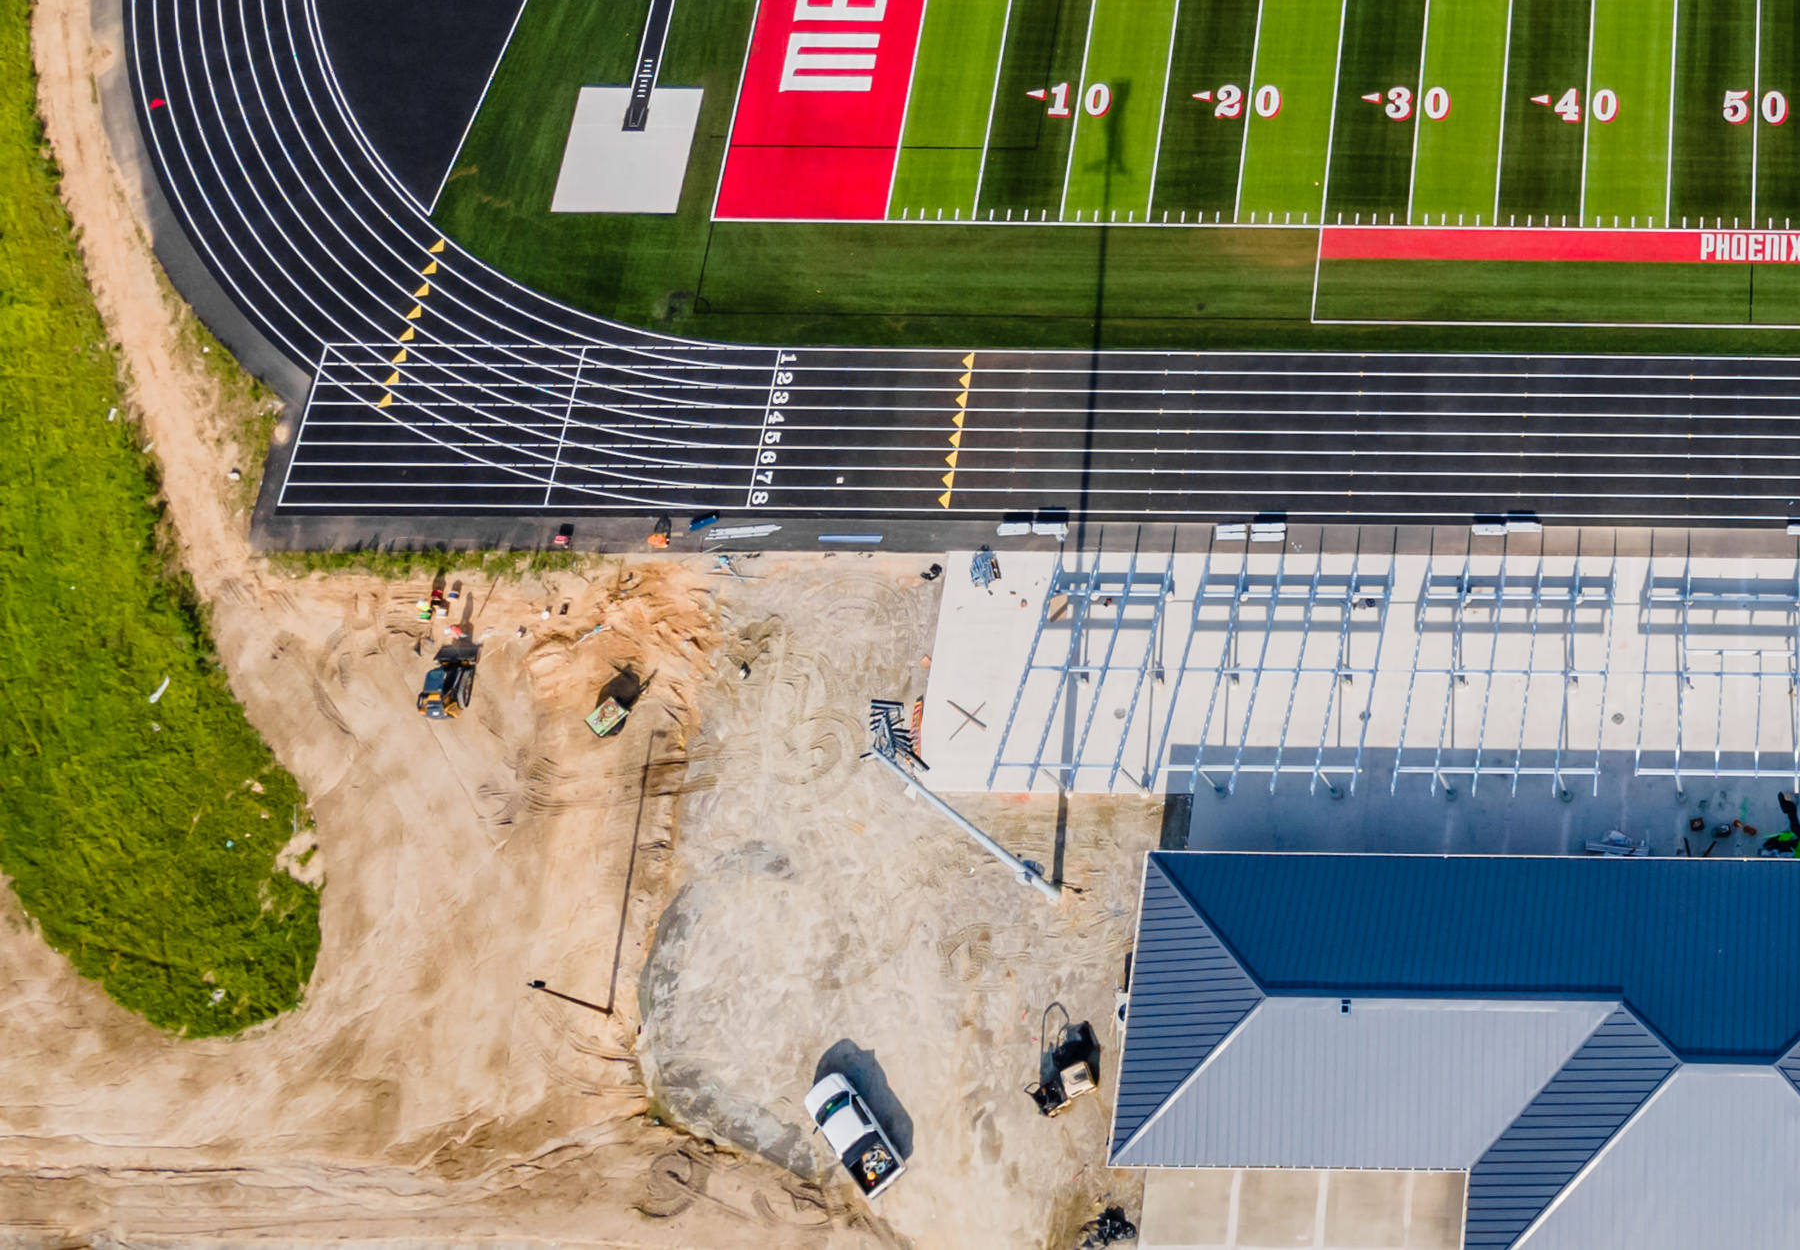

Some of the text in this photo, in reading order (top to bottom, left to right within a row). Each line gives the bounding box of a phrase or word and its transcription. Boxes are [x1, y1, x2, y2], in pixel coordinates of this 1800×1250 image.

[1047, 82, 1111, 117] 10
[1214, 84, 1281, 119] 20
[1384, 85, 1450, 121] 30
[1553, 87, 1618, 123] 40
[1722, 90, 1787, 124] 50
[780, 354, 797, 363] 1
[777, 372, 793, 385] 2
[773, 391, 789, 404] 3
[768, 411, 784, 424] 4
[764, 431, 781, 444] 5
[760, 451, 776, 464] 6
[756, 471, 773, 484] 7
[752, 491, 768, 504] 8
